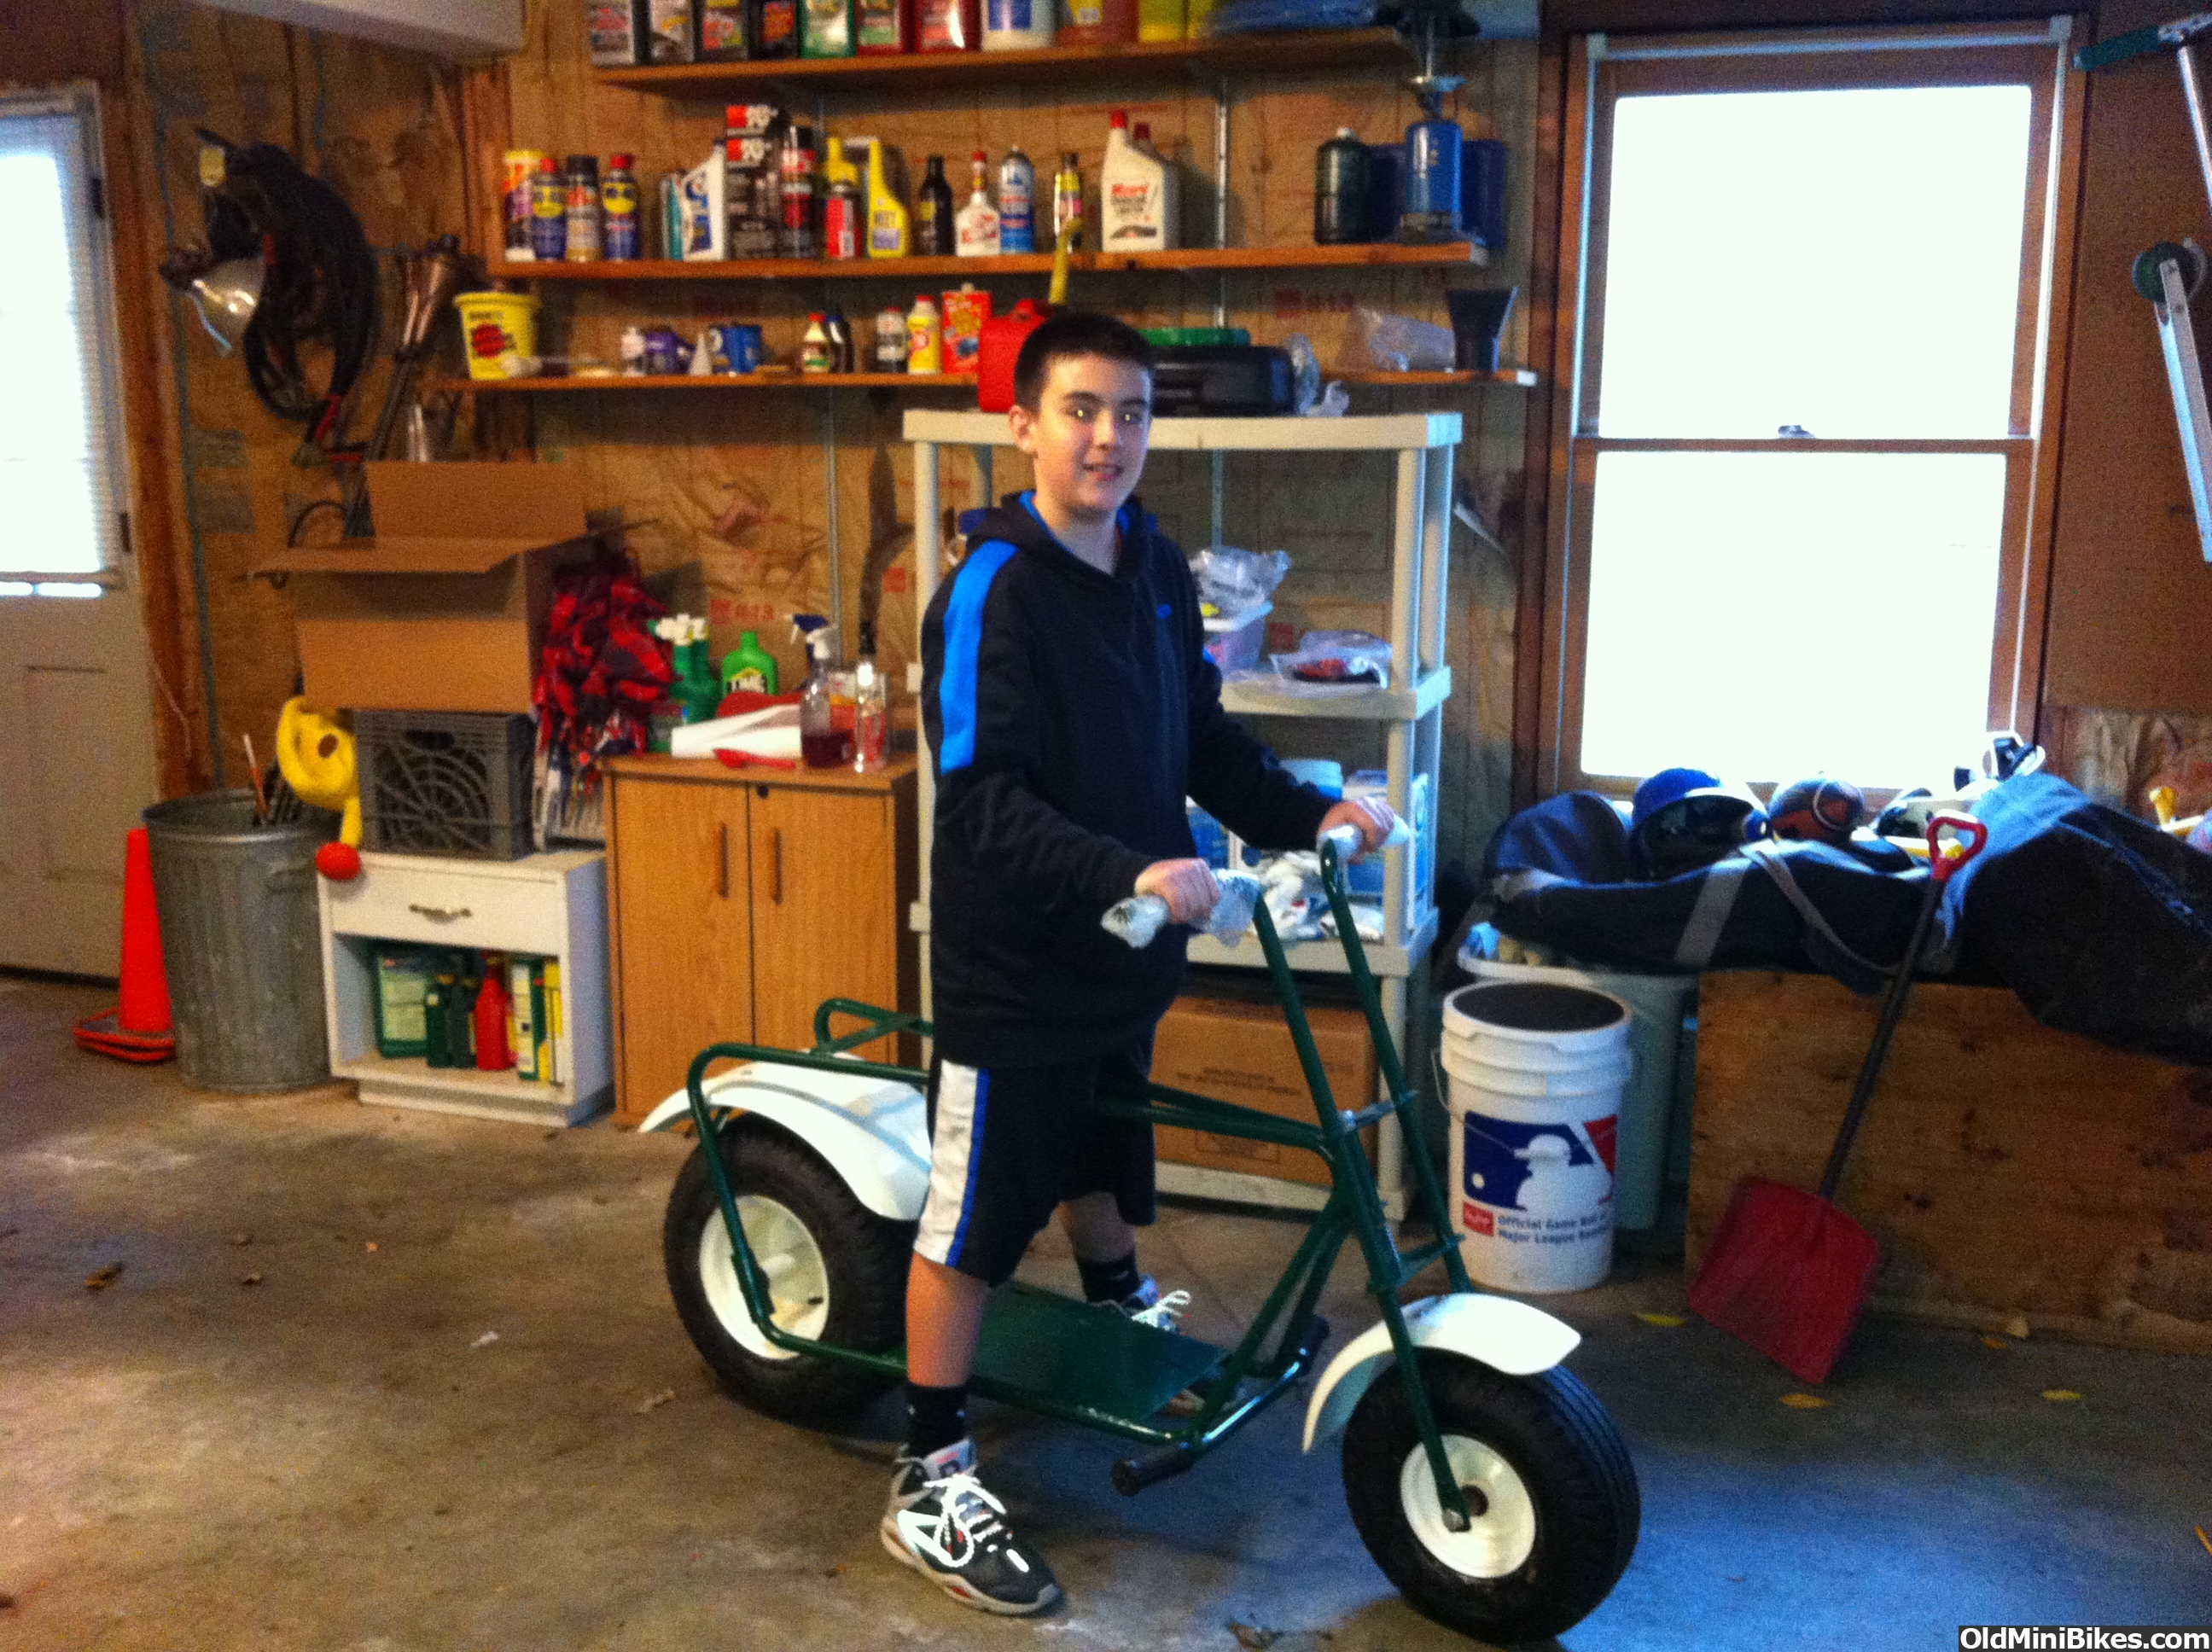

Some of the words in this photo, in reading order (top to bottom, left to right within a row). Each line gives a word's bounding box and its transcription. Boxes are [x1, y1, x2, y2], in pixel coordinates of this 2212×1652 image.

[1498, 1215, 1542, 1230] Official
[1545, 1218, 1578, 1230] Game
[1498, 1230, 1531, 1243] Major
[1534, 1233, 1577, 1248] League
